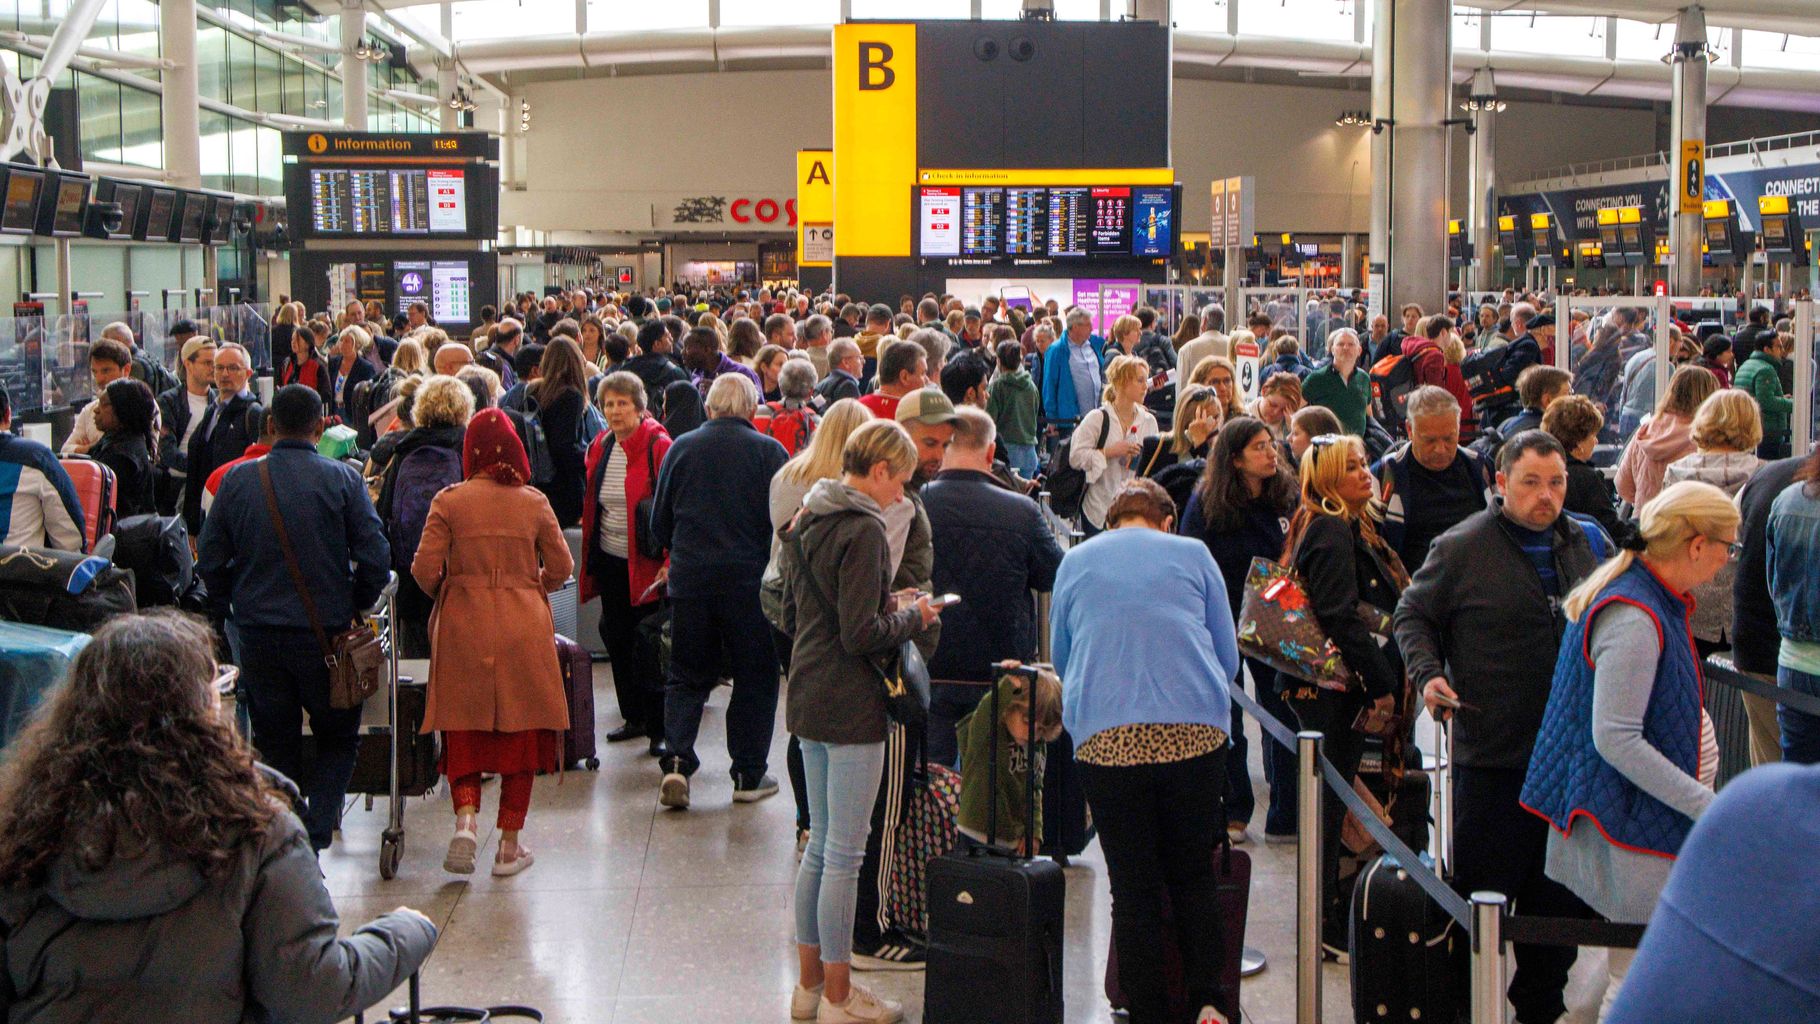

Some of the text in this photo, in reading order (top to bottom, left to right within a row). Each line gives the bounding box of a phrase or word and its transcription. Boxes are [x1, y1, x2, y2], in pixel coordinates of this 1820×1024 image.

[858, 41, 896, 91] B
[335, 138, 412, 150] Information
[806, 160, 831, 185] A
[1575, 194, 1642, 213] CONNECTING YOU
[1797, 199, 1820, 217] THE
[1576, 215, 1595, 230] WITH
